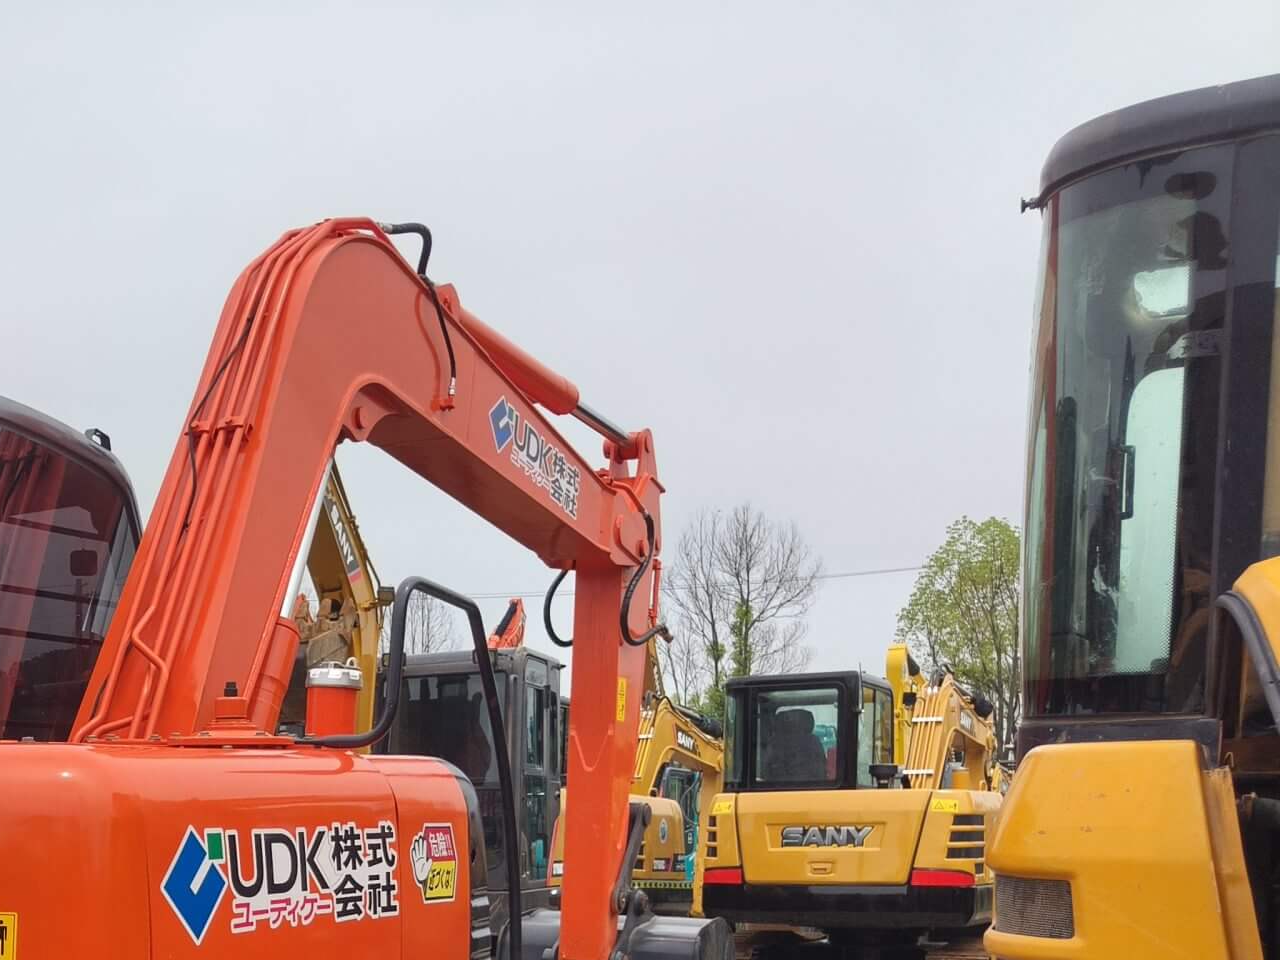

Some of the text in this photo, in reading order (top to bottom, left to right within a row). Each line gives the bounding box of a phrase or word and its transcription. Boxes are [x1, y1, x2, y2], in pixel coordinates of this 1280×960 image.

[514, 412, 553, 478] UDK
[677, 731, 694, 750] SANY
[782, 825, 874, 847] SANY
[227, 829, 330, 898] UDK
[232, 895, 332, 929] ユーディケー
